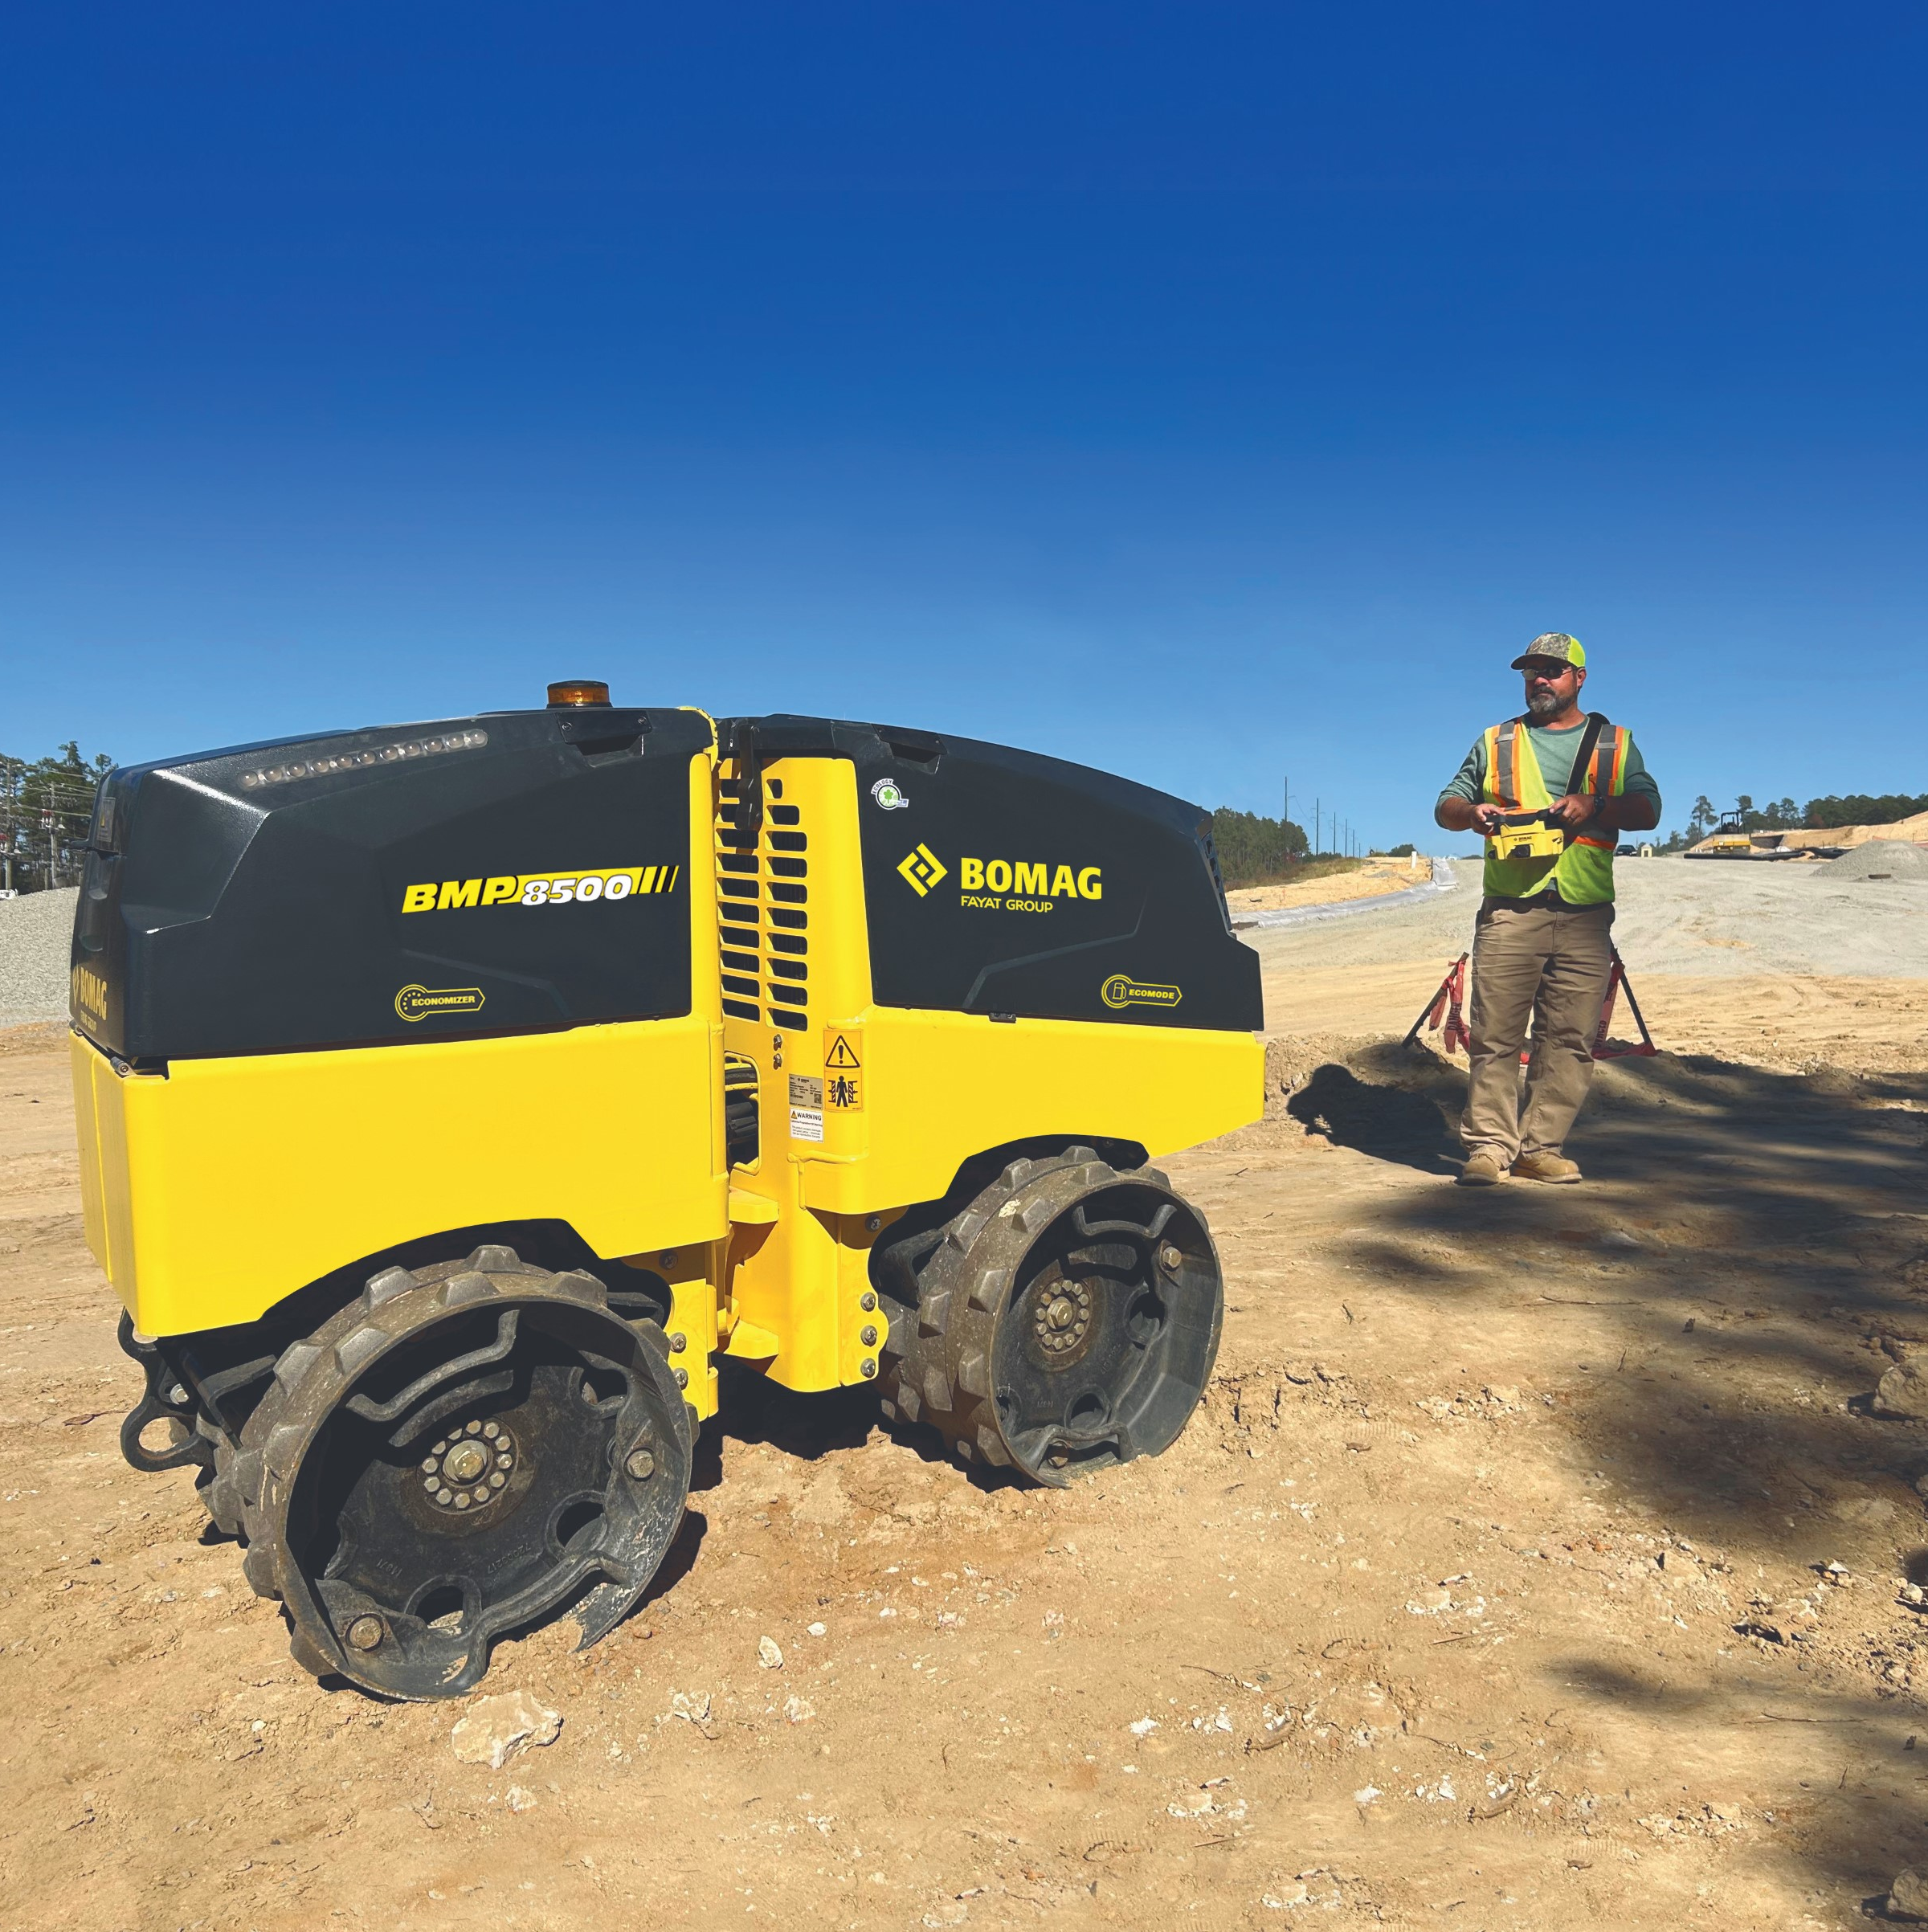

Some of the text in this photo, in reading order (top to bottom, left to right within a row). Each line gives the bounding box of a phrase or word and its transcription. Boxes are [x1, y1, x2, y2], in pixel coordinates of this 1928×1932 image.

[872, 778, 893, 794] ECOLOGY
[961, 857, 1102, 900] BOMAG
[402, 874, 633, 913] BMP 8500
[961, 895, 1053, 913] FAYAT GROUP
[80, 966, 107, 1021] BOMAG
[411, 995, 476, 1007] ECONOMIZER
[1129, 989, 1174, 999] ECOMODE
[797, 1112, 822, 1121] WARNING
